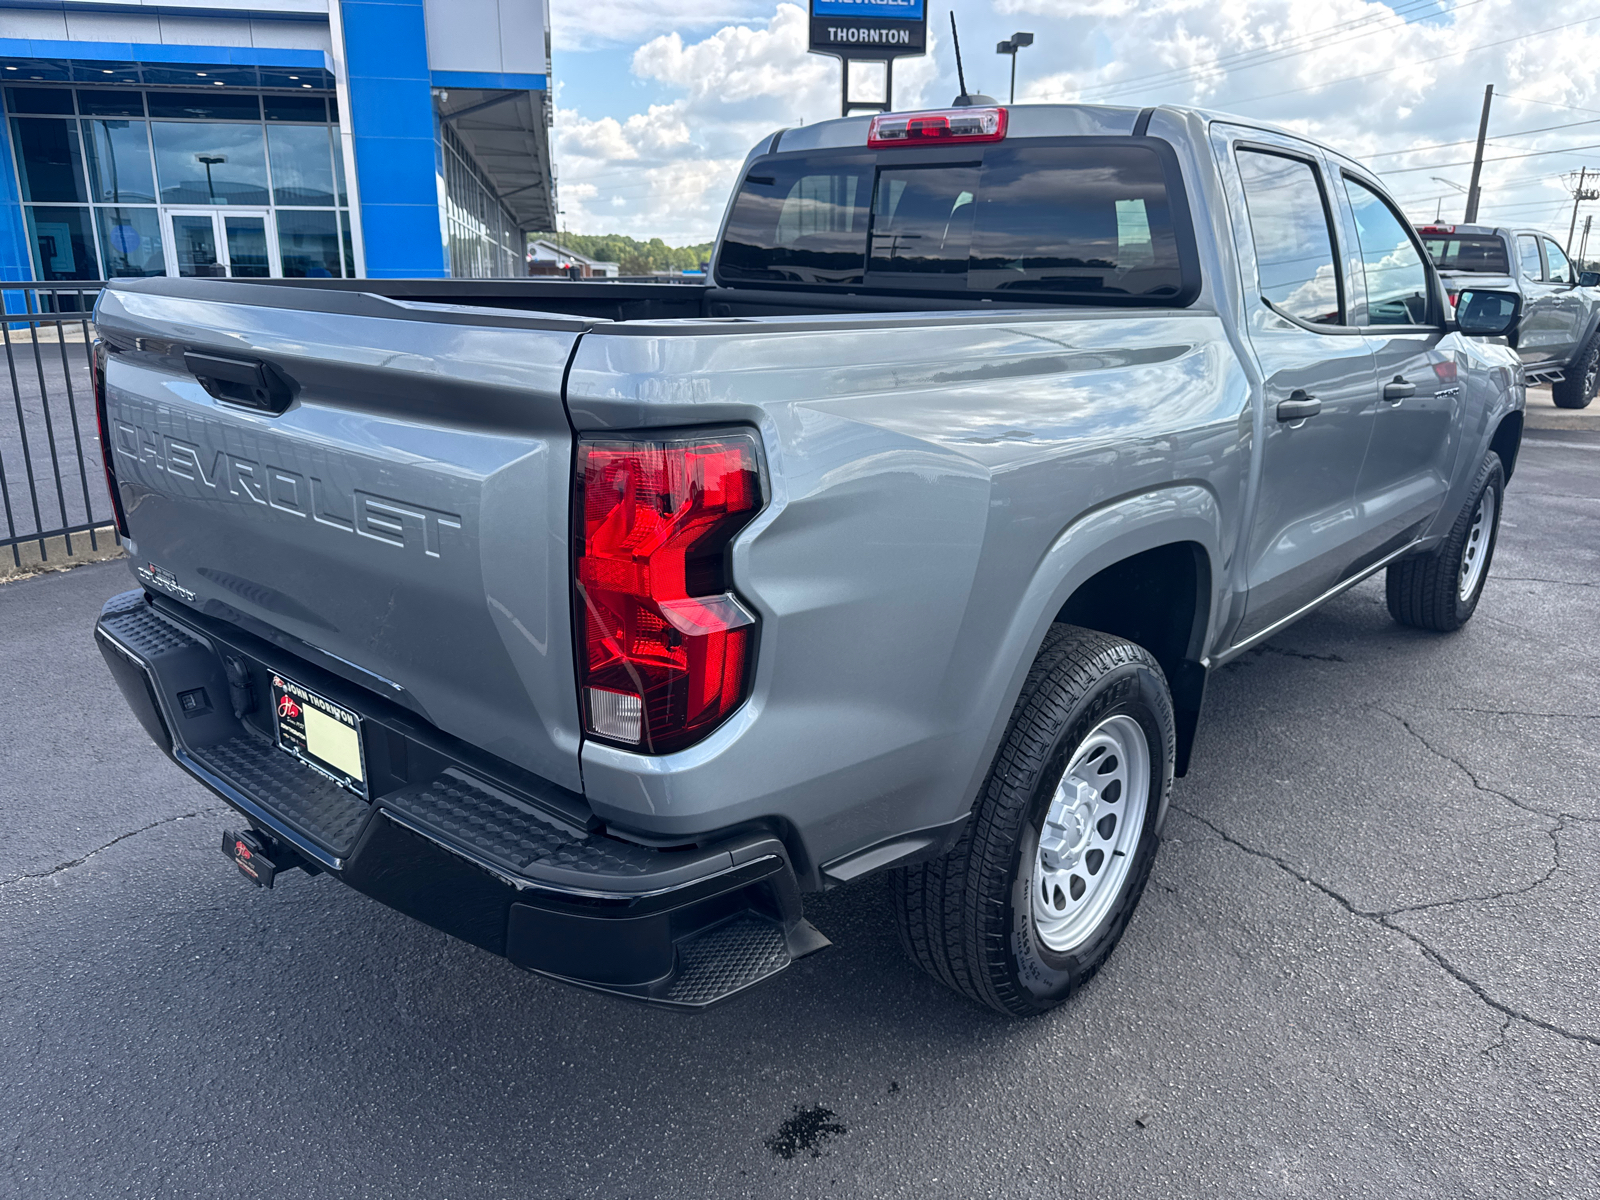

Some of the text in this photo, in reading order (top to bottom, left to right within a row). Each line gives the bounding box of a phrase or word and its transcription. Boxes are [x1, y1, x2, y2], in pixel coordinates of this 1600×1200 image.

[827, 27, 910, 44] THORNTON
[114, 417, 461, 558] CHEVROLET
[287, 682, 355, 727] JOHN THORNTON
